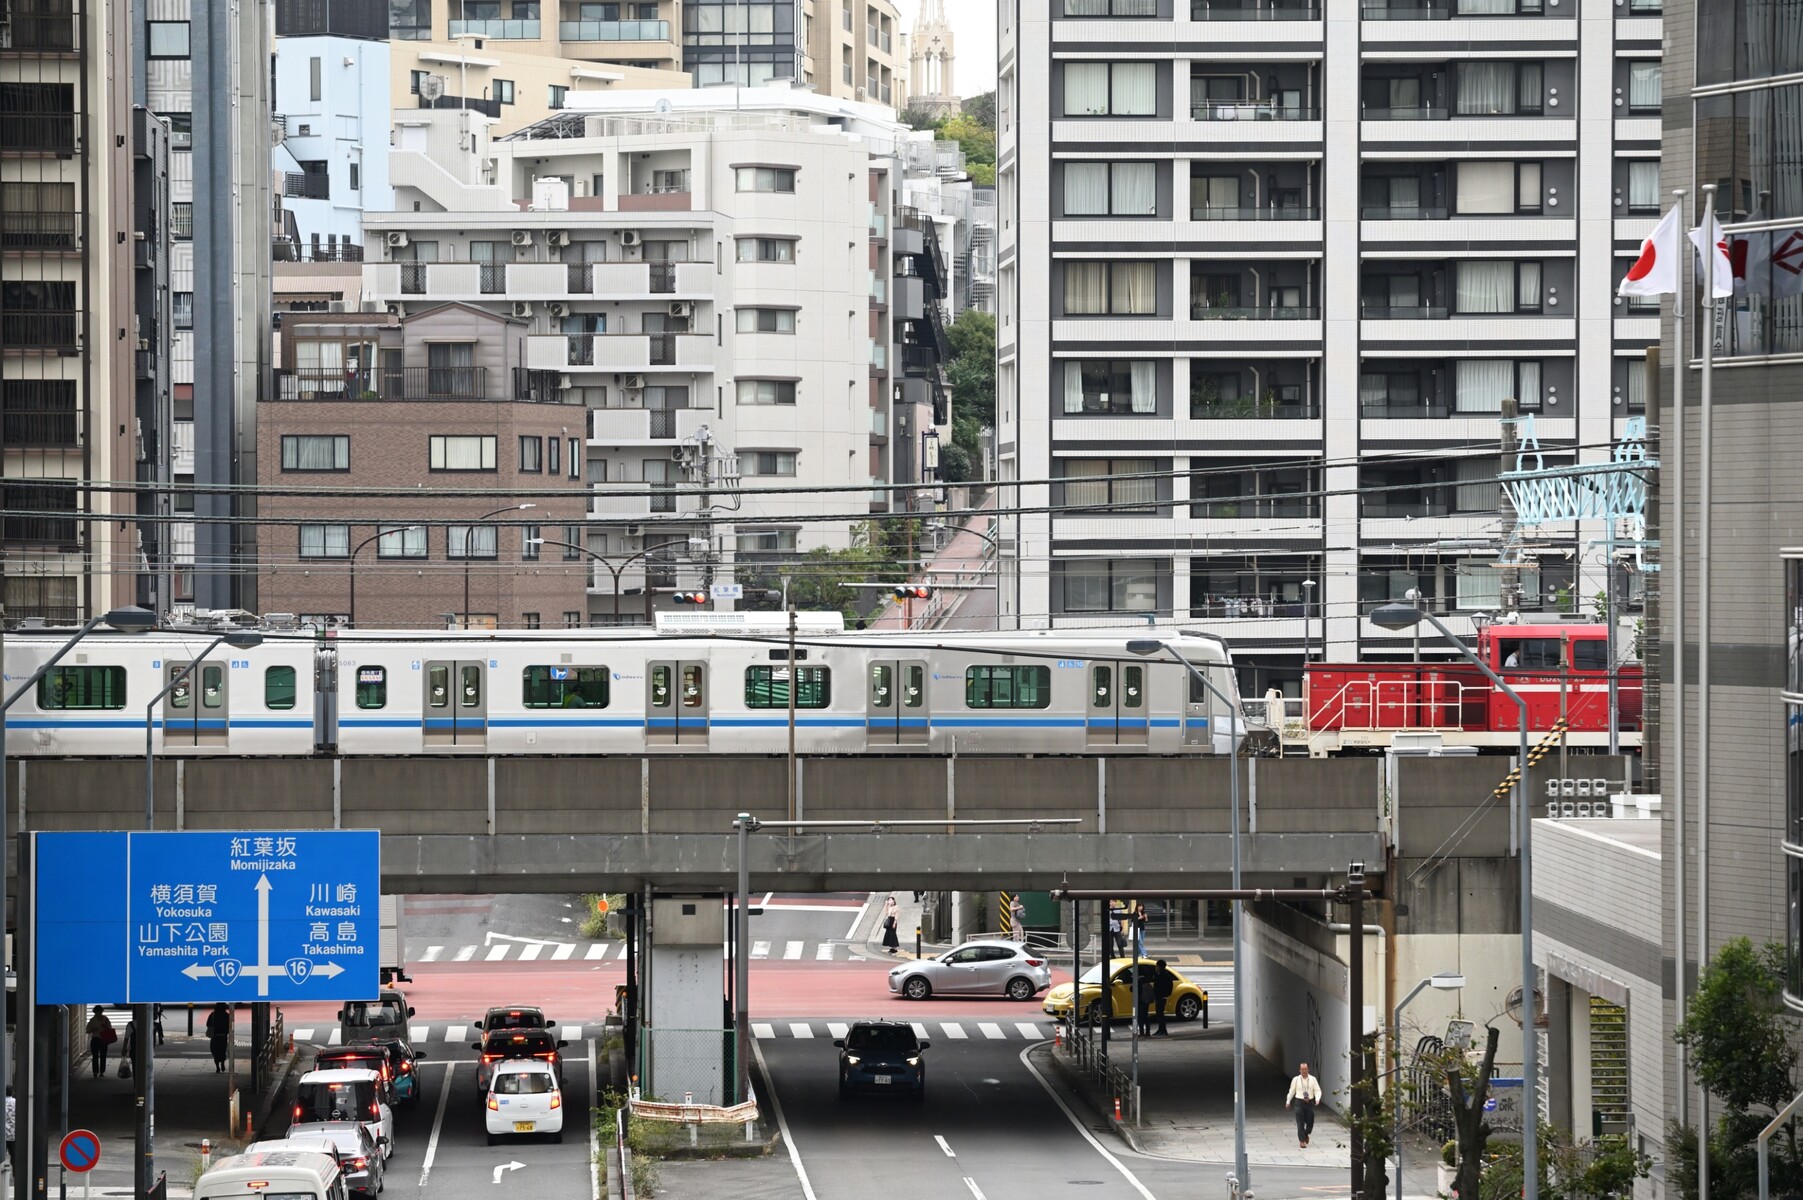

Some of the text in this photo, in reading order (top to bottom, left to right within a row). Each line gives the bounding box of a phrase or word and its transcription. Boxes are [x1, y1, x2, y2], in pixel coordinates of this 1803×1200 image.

[230, 836, 297, 857] 紅葉坂
[230, 859, 296, 873] Momijizaka
[150, 883, 218, 905] 横須賀
[309, 882, 357, 904] 川崎
[156, 905, 212, 918] Yokosuka
[305, 905, 361, 917] Kawasaki
[139, 922, 228, 943] 山下公園
[309, 921, 357, 942] 高島
[138, 945, 229, 957] Yamashita Park
[302, 943, 364, 955] Takashima
[218, 961, 235, 978] 16
[290, 960, 306, 977] 16
